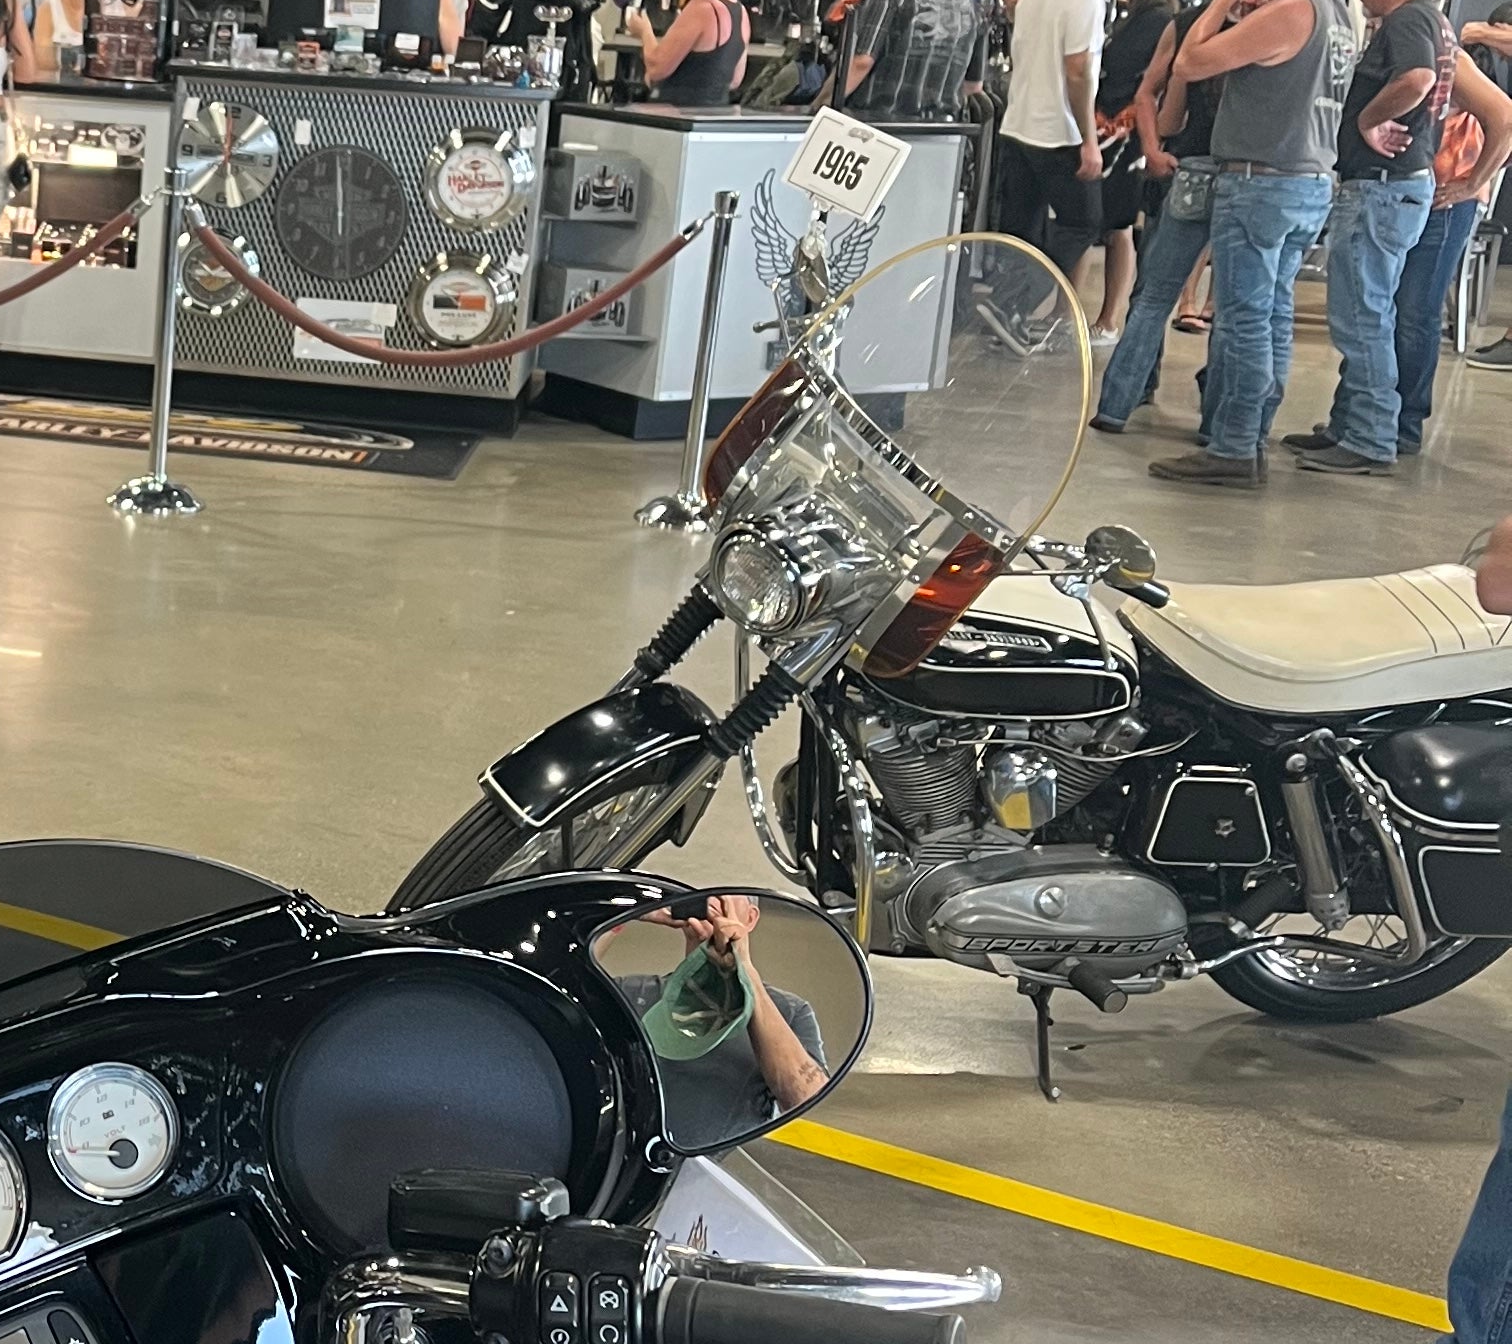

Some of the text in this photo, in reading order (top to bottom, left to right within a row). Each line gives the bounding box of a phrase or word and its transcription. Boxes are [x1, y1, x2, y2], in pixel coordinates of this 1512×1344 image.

[813, 141, 870, 190] 1965
[965, 936, 1159, 954] SPORTSTER
[104, 1125, 126, 1138] VOLT
